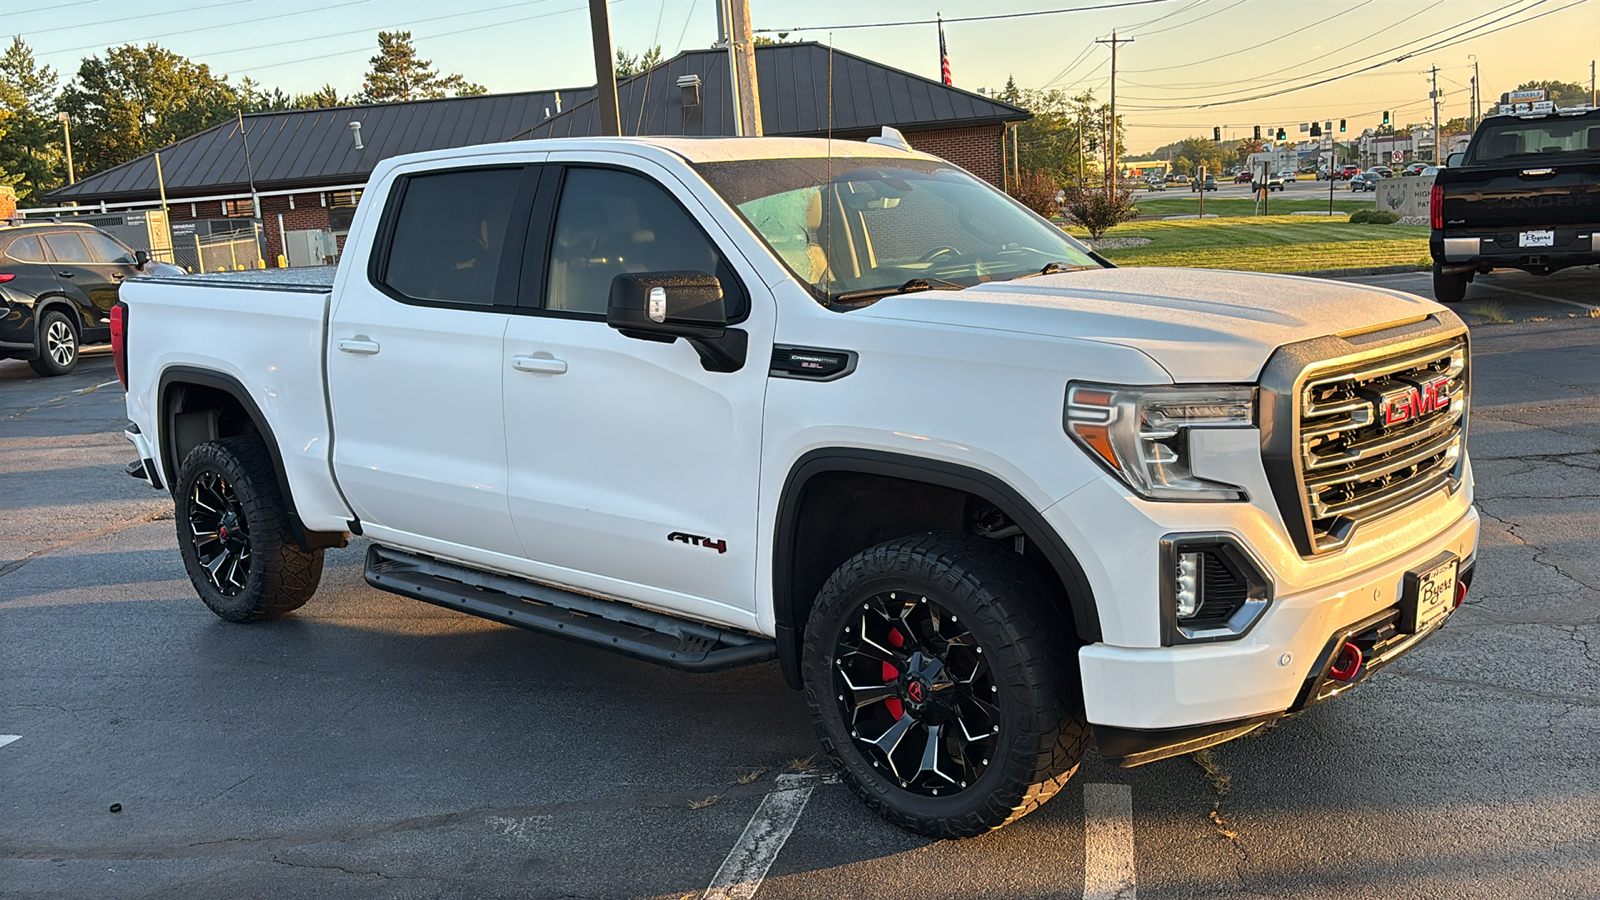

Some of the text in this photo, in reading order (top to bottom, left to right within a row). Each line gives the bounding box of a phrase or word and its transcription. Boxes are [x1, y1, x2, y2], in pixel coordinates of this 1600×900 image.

[1522, 233, 1551, 243] Byers
[1385, 378, 1449, 424] GMC
[667, 531, 728, 554] AT4
[1420, 577, 1452, 605] Byers
